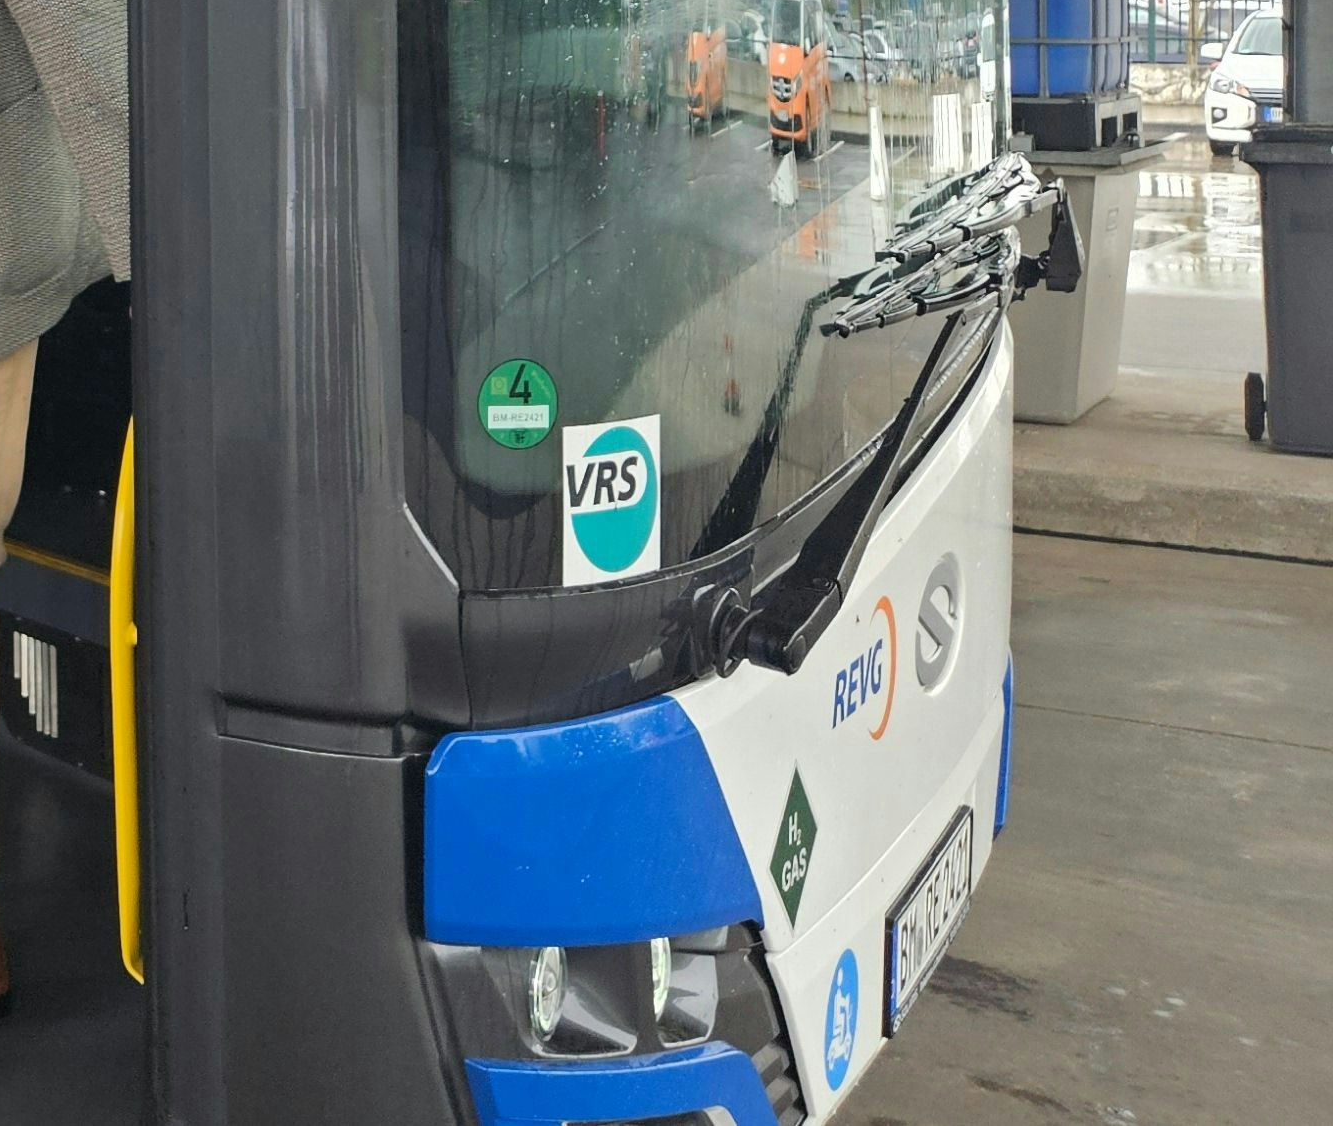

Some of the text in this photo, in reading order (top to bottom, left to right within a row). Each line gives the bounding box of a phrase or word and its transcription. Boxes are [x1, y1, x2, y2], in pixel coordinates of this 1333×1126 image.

[509, 363, 532, 404] 4
[566, 456, 639, 508] VRS
[832, 638, 883, 730] REVG
[788, 811, 802, 846] H2
[781, 847, 808, 893] GAS
[900, 903, 917, 993] BM
[925, 869, 941, 953] RE
